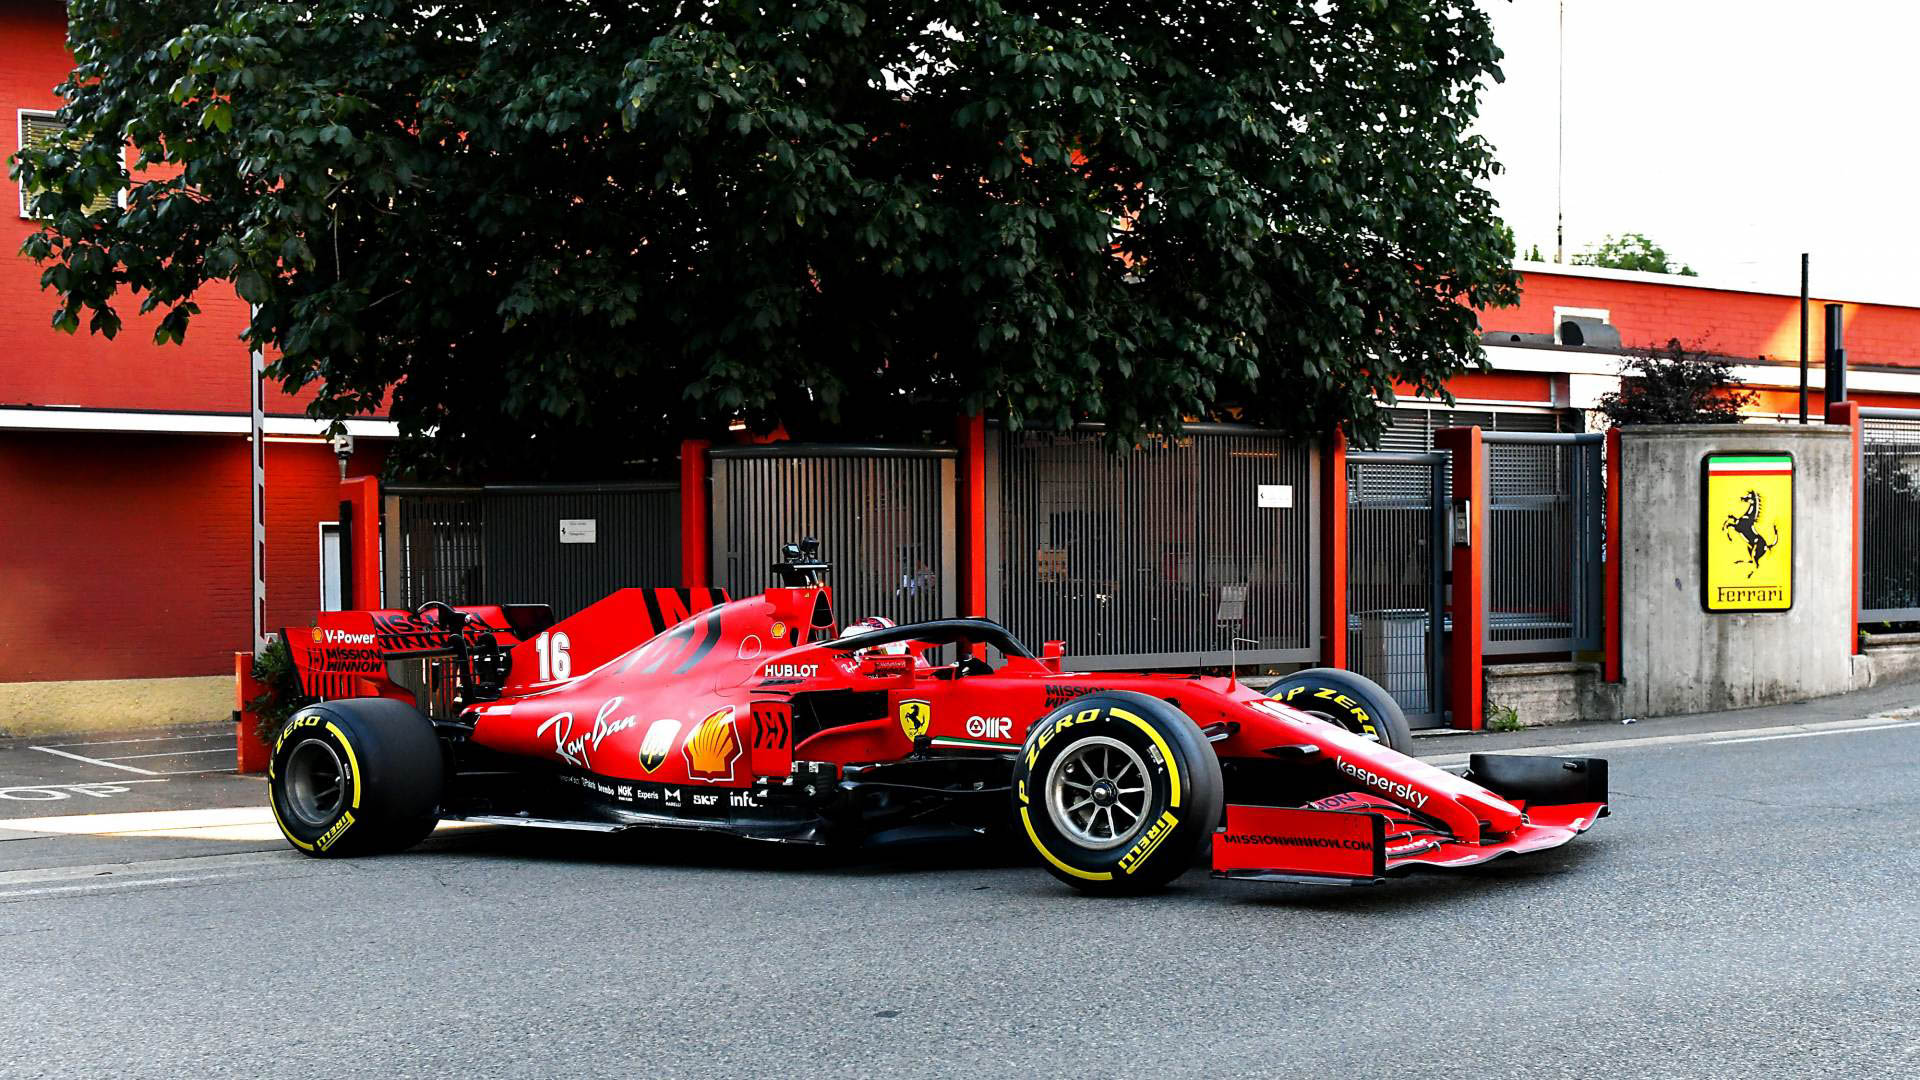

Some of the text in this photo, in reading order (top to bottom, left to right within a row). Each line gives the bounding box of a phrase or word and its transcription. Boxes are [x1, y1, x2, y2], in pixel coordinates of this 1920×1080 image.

[1717, 585, 1783, 602] Ferrari
[325, 629, 376, 644] V-Power
[326, 648, 381, 660] MISSION
[535, 631, 571, 681] 16
[327, 661, 382, 672] WINNOW
[764, 664, 819, 678] HUBLOT
[276, 715, 321, 755] ZERO
[1019, 779, 1030, 804] P
[1025, 708, 1101, 771] ZERO
[1336, 755, 1429, 808] kaspersky
[617, 785, 633, 797] NGK
[637, 790, 659, 800] Experis
[693, 794, 719, 806] SKF
[316, 810, 356, 852] PIRELLI
[1118, 810, 1179, 875] PIRELLI
[1223, 834, 1373, 851] MISSIONWINNOW.COM
